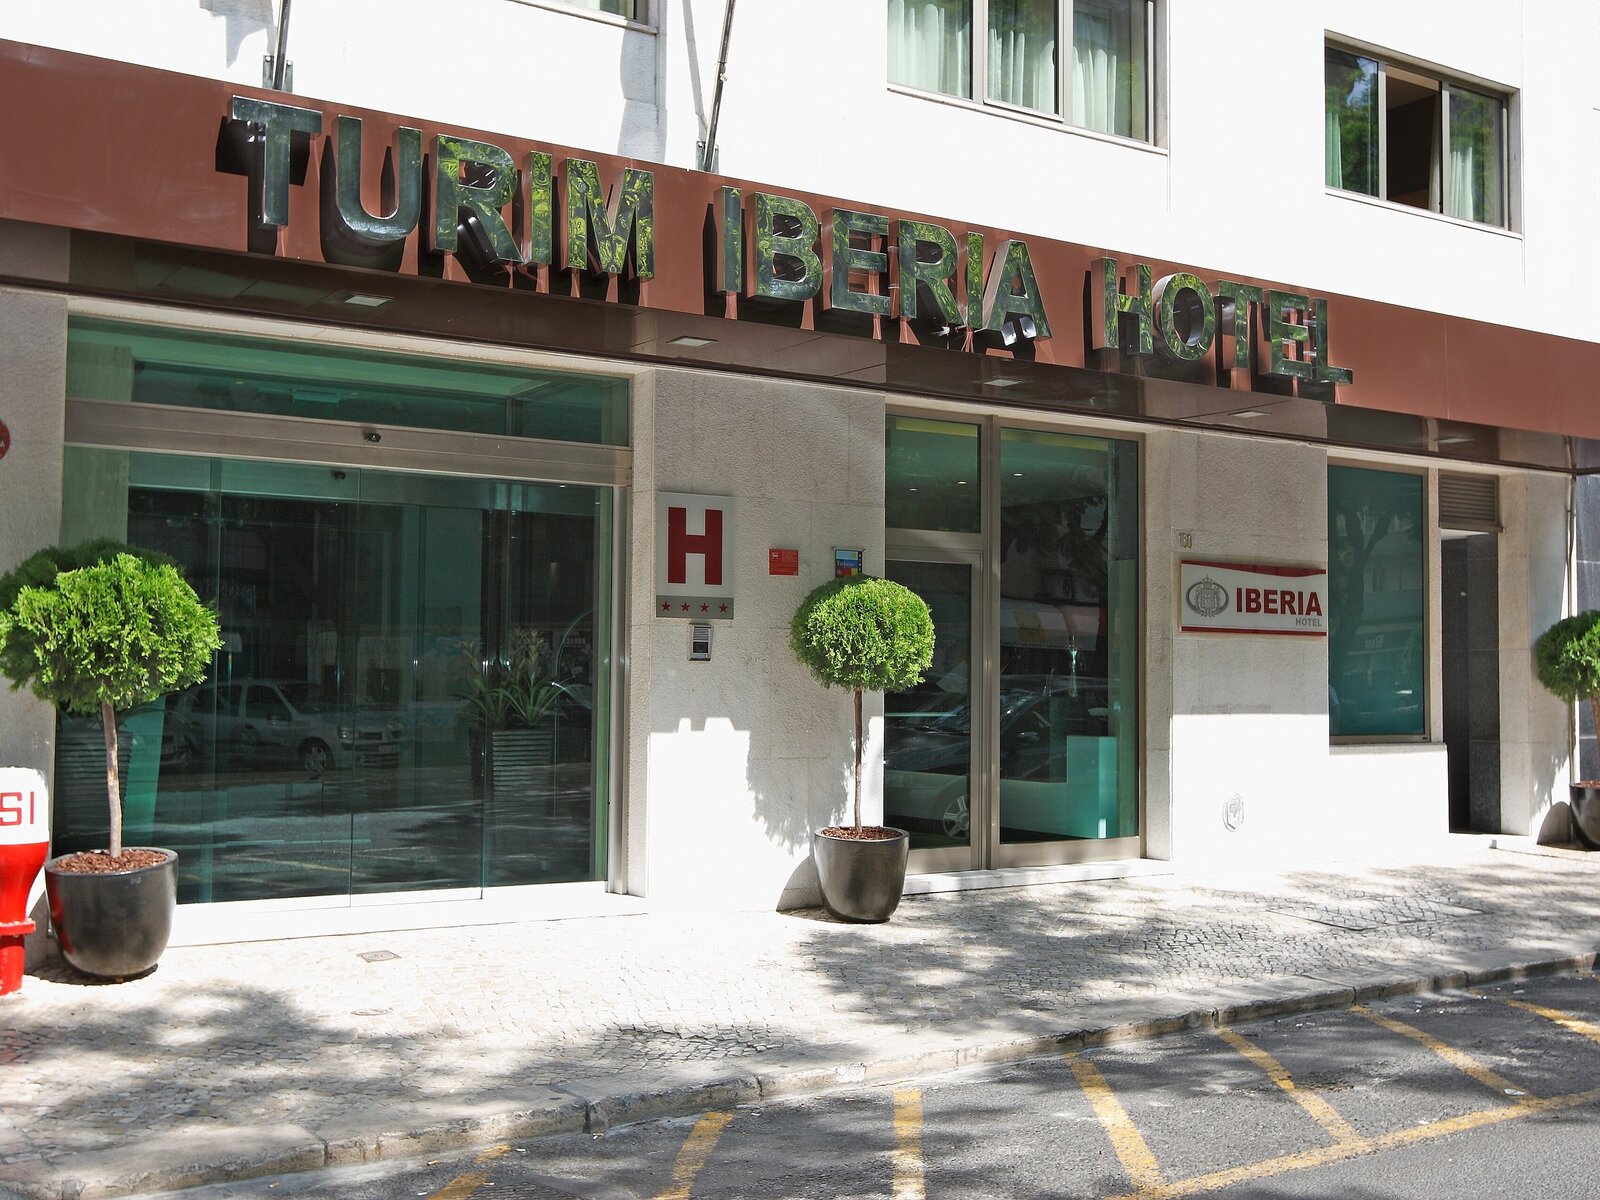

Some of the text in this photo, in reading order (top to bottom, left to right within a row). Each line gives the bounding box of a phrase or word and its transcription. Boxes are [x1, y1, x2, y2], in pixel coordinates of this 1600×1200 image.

[230, 94, 1354, 386] TURIM IBERIA HOTEL
[667, 506, 723, 586] H
[1236, 587, 1323, 616] IBERIA
[1295, 617, 1322, 627] HOTEL
